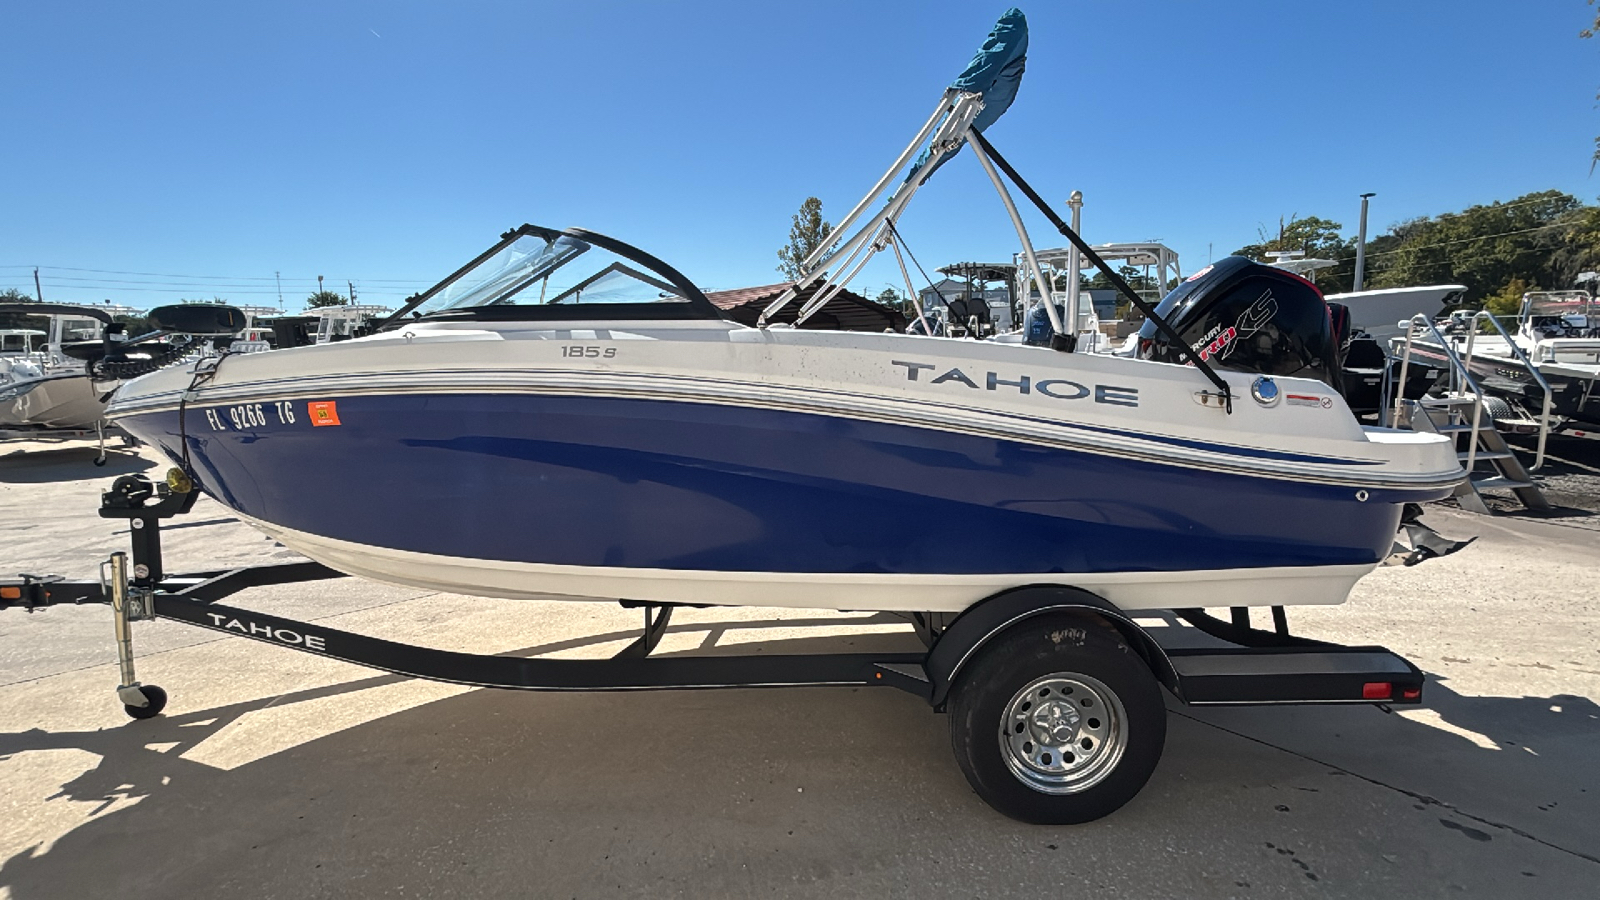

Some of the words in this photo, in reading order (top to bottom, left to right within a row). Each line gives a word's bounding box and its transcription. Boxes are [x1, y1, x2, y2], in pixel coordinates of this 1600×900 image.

[561, 346, 600, 358] 185
[1179, 322, 1221, 361] MRCURY
[891, 359, 1139, 408] TAHOE
[205, 408, 226, 430] FL
[230, 404, 266, 430] 9266
[275, 401, 296, 424] TG
[206, 612, 326, 651] TAHOE
